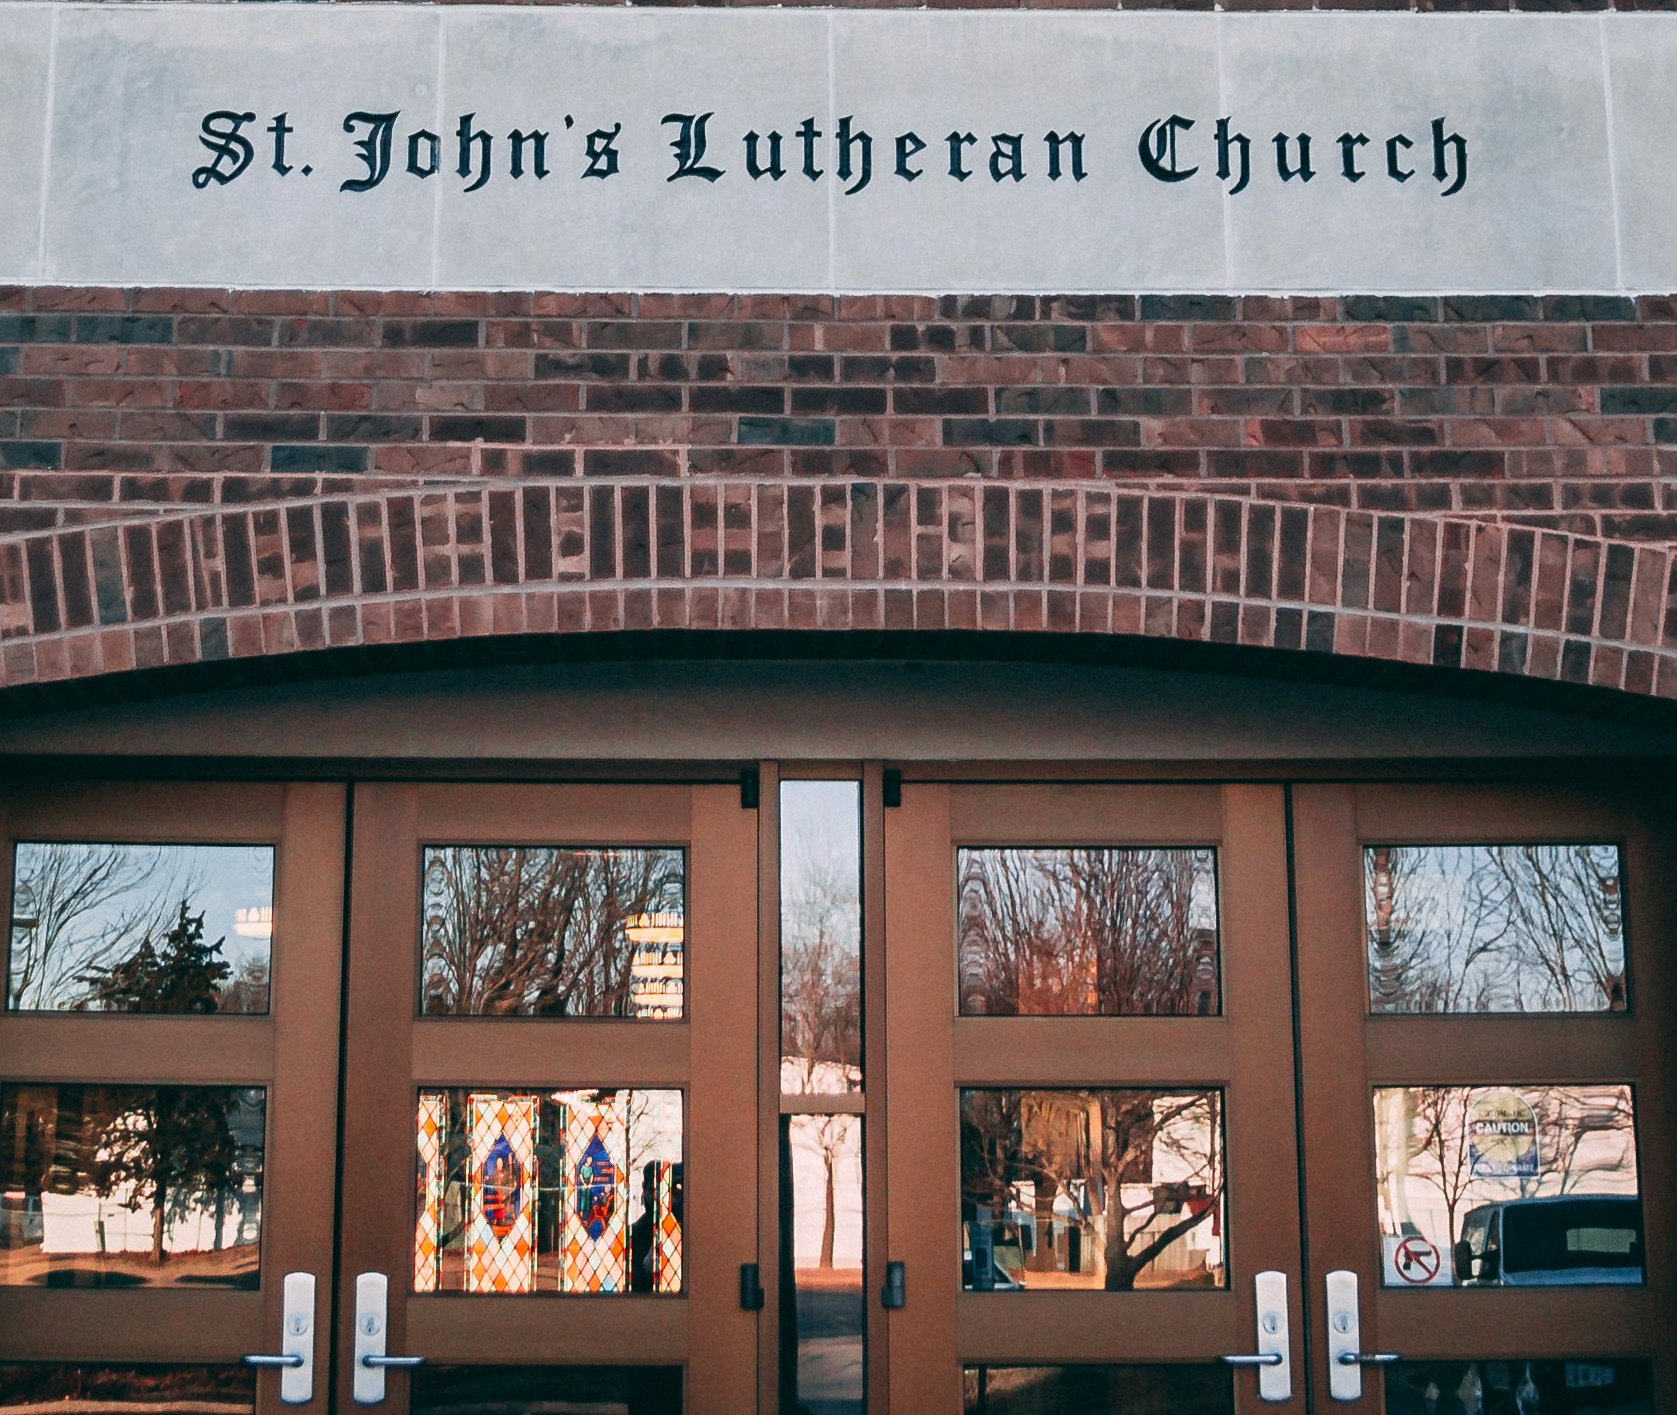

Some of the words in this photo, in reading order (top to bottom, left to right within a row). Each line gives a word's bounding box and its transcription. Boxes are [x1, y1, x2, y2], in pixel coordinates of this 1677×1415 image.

[190, 109, 315, 190] St.
[338, 109, 623, 193] John's
[659, 110, 1090, 196] Lutheran
[1136, 113, 1469, 197] Church
[1474, 1121, 1530, 1134] CAUTION
